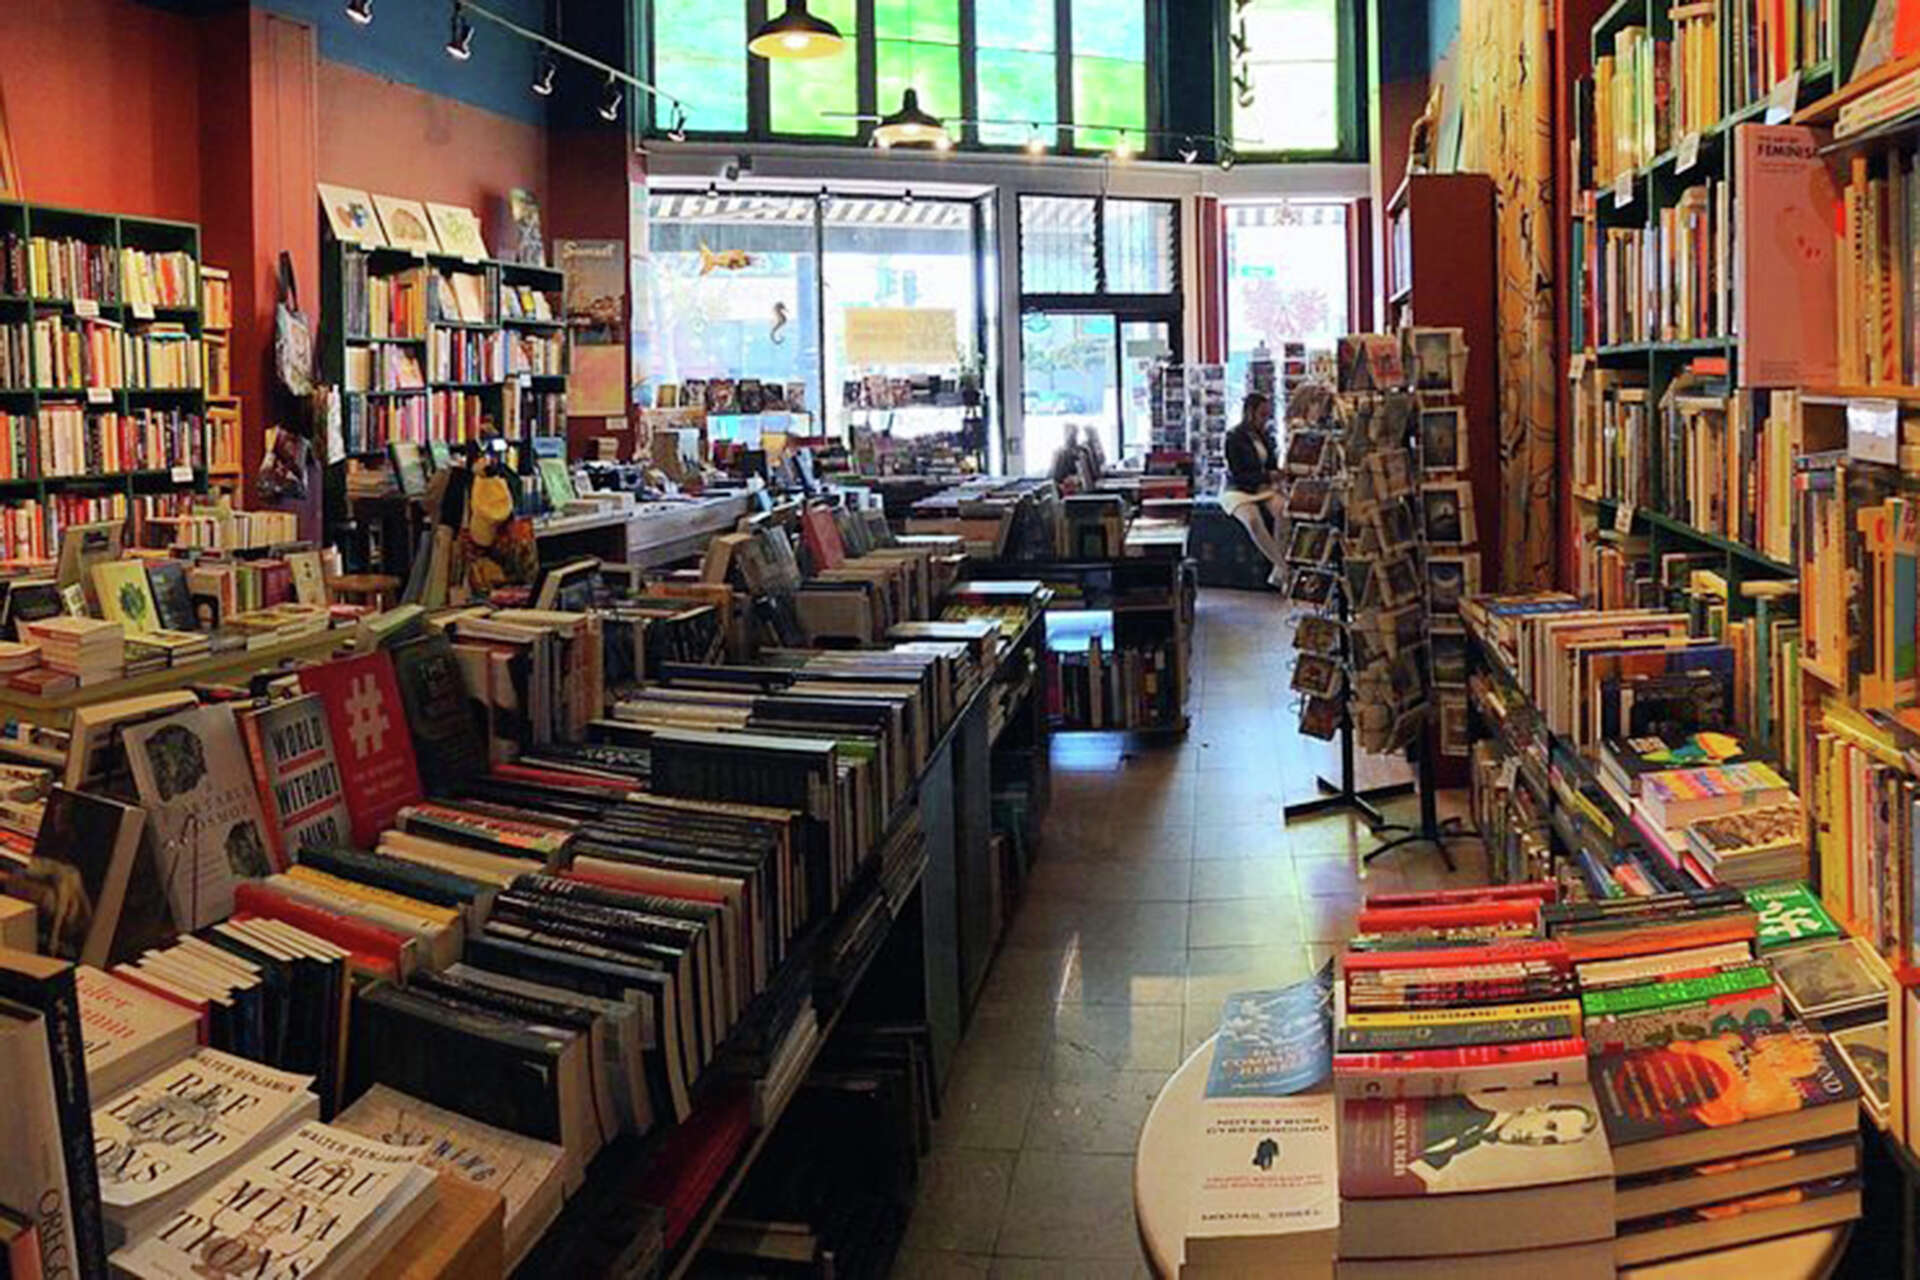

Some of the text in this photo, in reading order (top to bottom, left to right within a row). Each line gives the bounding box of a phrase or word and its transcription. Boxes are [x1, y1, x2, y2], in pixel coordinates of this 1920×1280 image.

[271, 715, 324, 763] WORLD
[274, 761, 341, 818] WITHOUT
[165, 1072, 260, 1116] REF
[108, 1095, 227, 1154] LECT
[301, 1129, 348, 1153] WALTER
[93, 1135, 172, 1184] ONS
[271, 1149, 388, 1197] ILLU
[216, 1180, 343, 1241] MINA
[159, 1209, 314, 1280] TIONS
